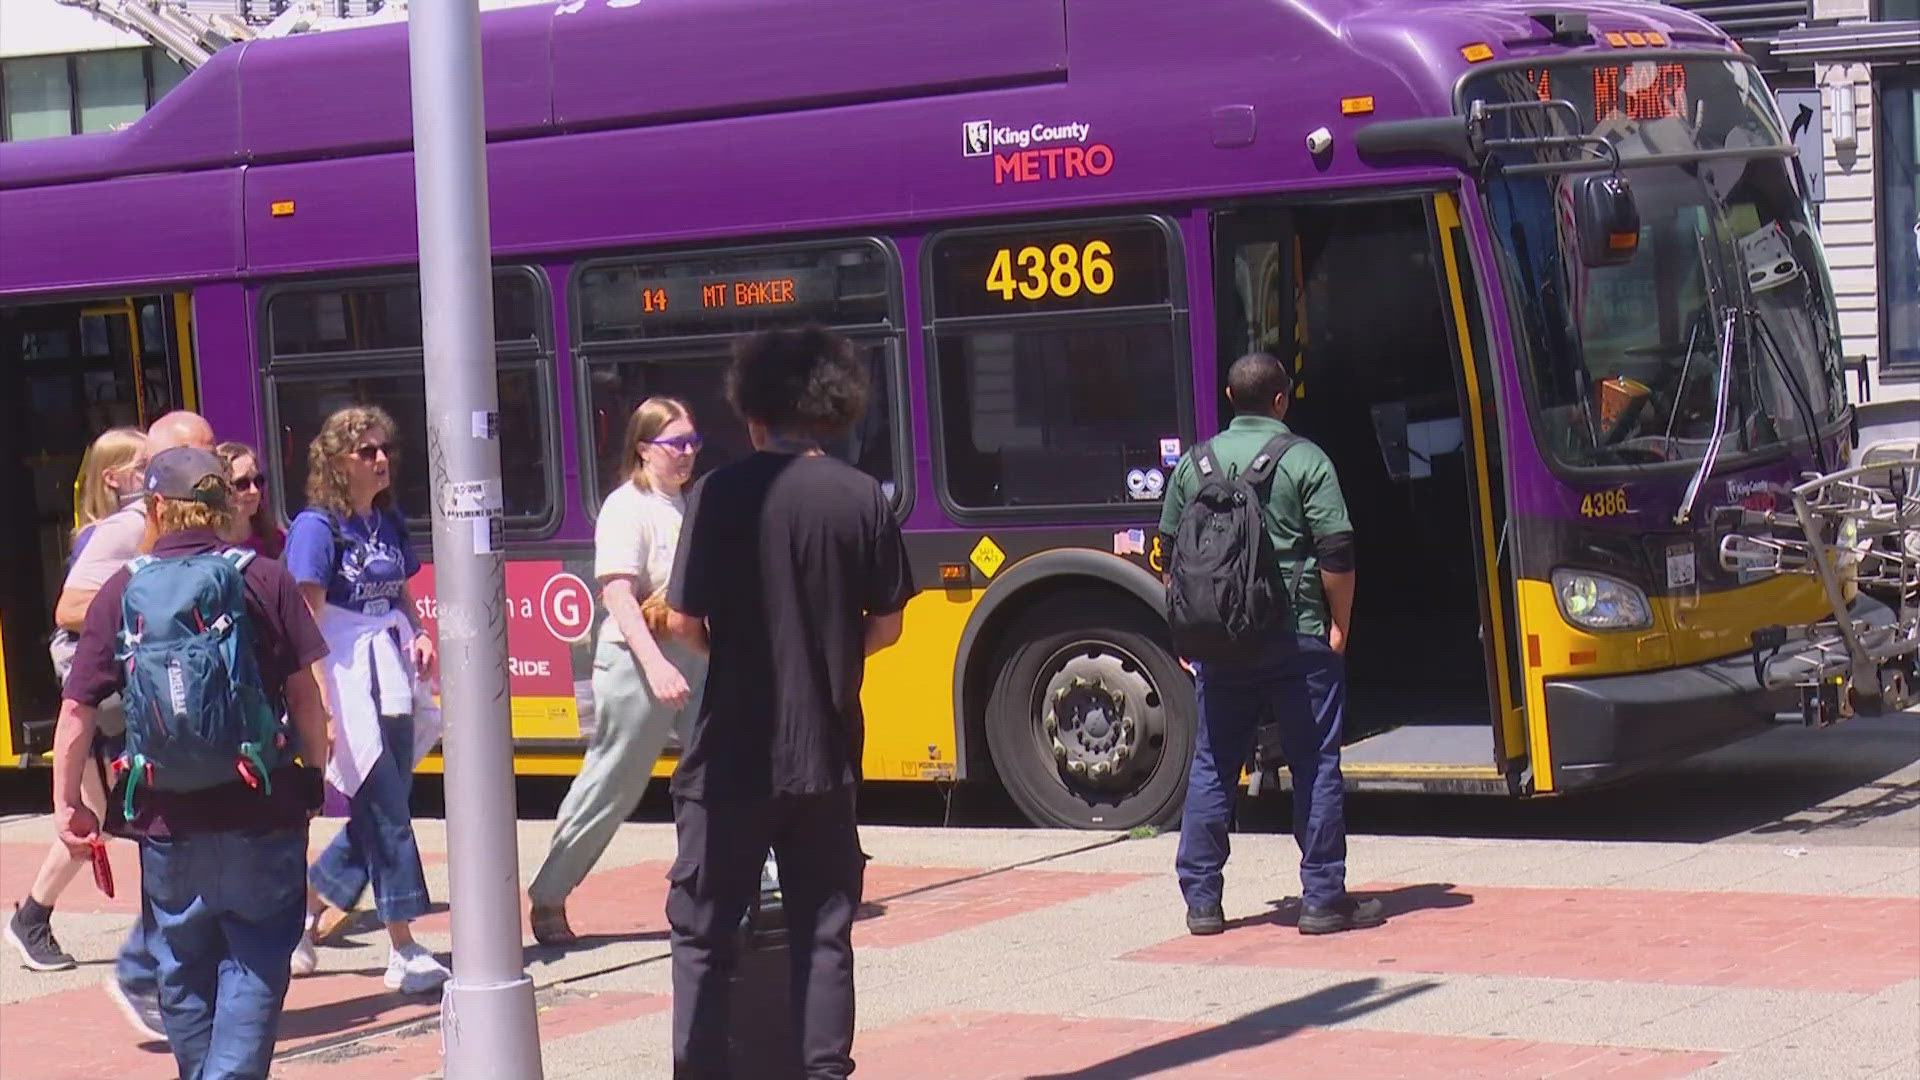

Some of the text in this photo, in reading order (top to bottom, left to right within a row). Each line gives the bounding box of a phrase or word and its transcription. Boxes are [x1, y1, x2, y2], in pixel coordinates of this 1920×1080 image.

[1594, 66, 1618, 121] MT
[1625, 64, 1687, 119] BAKER
[993, 121, 1090, 147] King County
[994, 144, 1114, 184] METRO
[986, 240, 1114, 300] 4386
[643, 279, 794, 312] 14 MT BAKER
[1581, 489, 1627, 518] 4386
[520, 598, 532, 618] a
[553, 589, 580, 627] G
